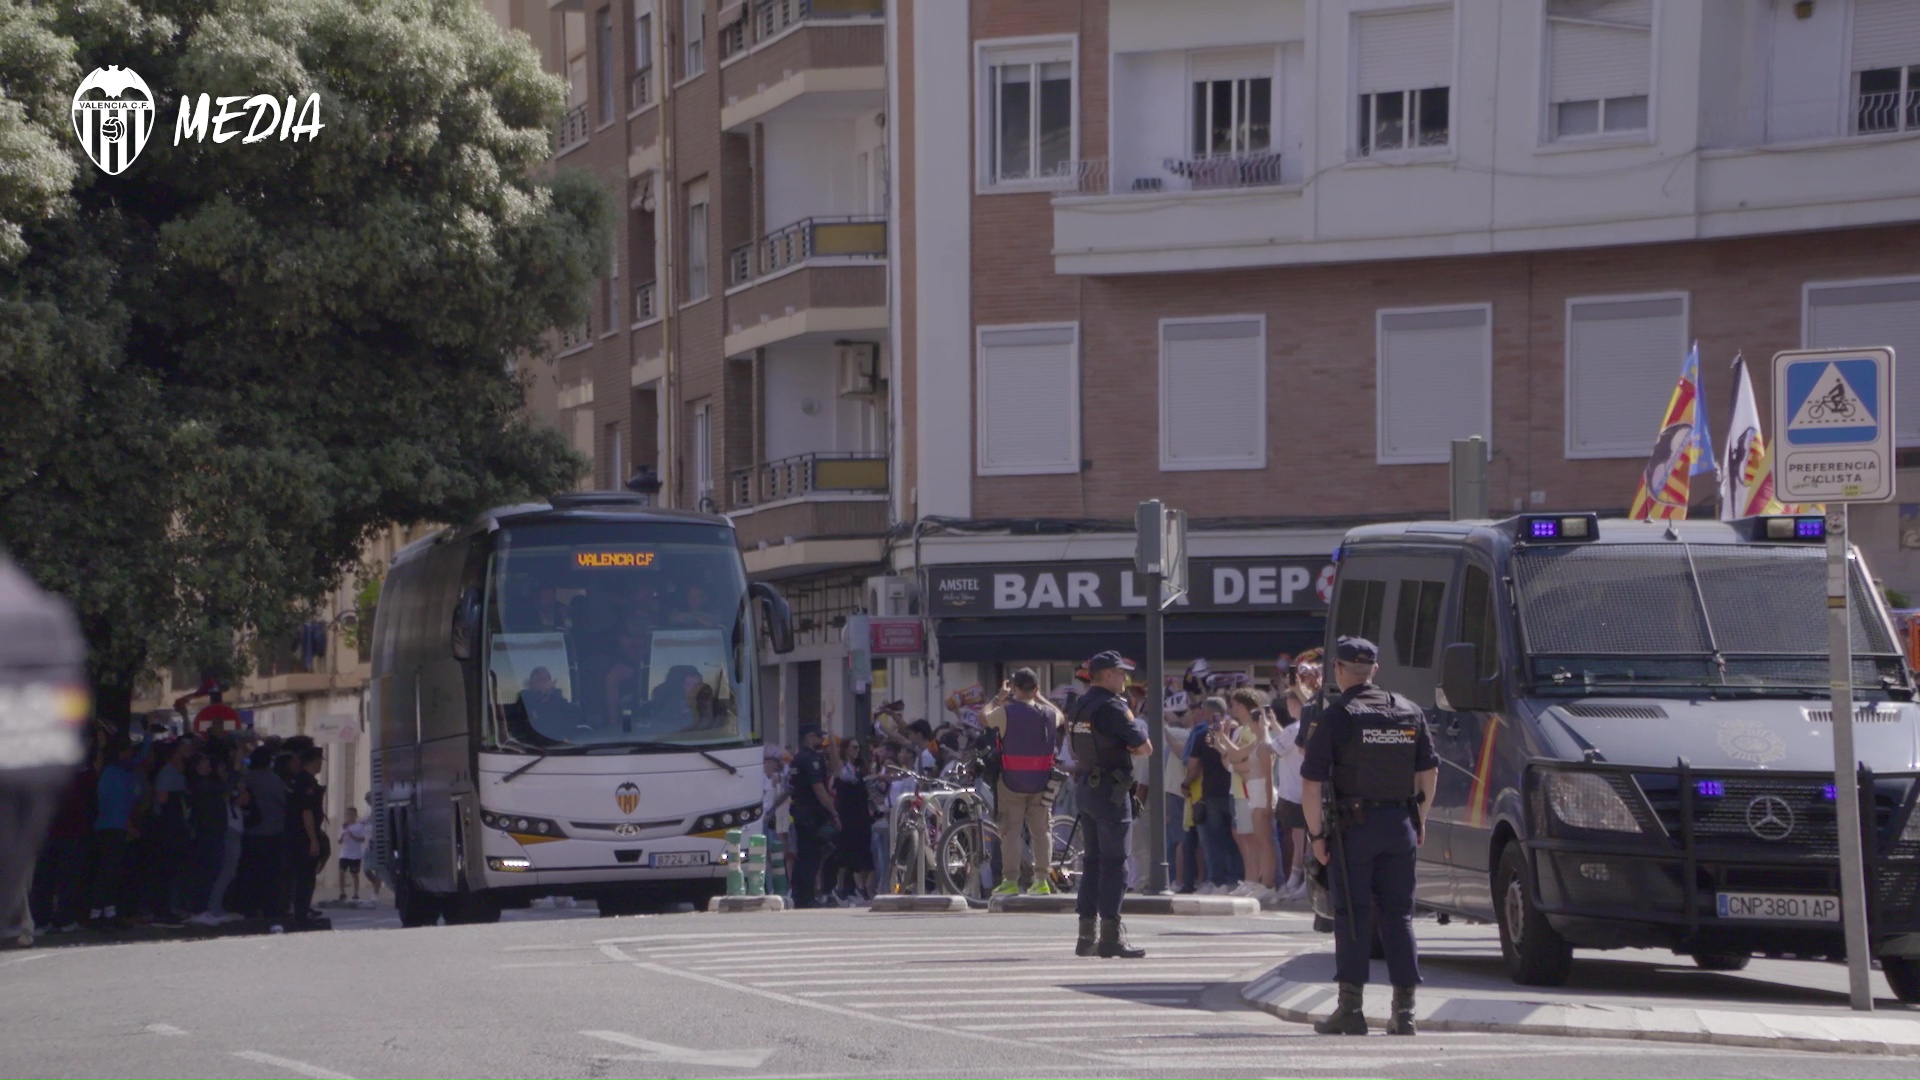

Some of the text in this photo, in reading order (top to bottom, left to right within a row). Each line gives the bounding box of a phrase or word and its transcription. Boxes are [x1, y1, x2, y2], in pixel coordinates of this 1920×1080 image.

[1789, 461, 1876, 472] PREFERENCIA
[1803, 474, 1862, 484] CICLISTA
[577, 553, 634, 566] VALENCIA
[938, 578, 980, 591] AMSTEL
[994, 572, 1102, 609] BAR
